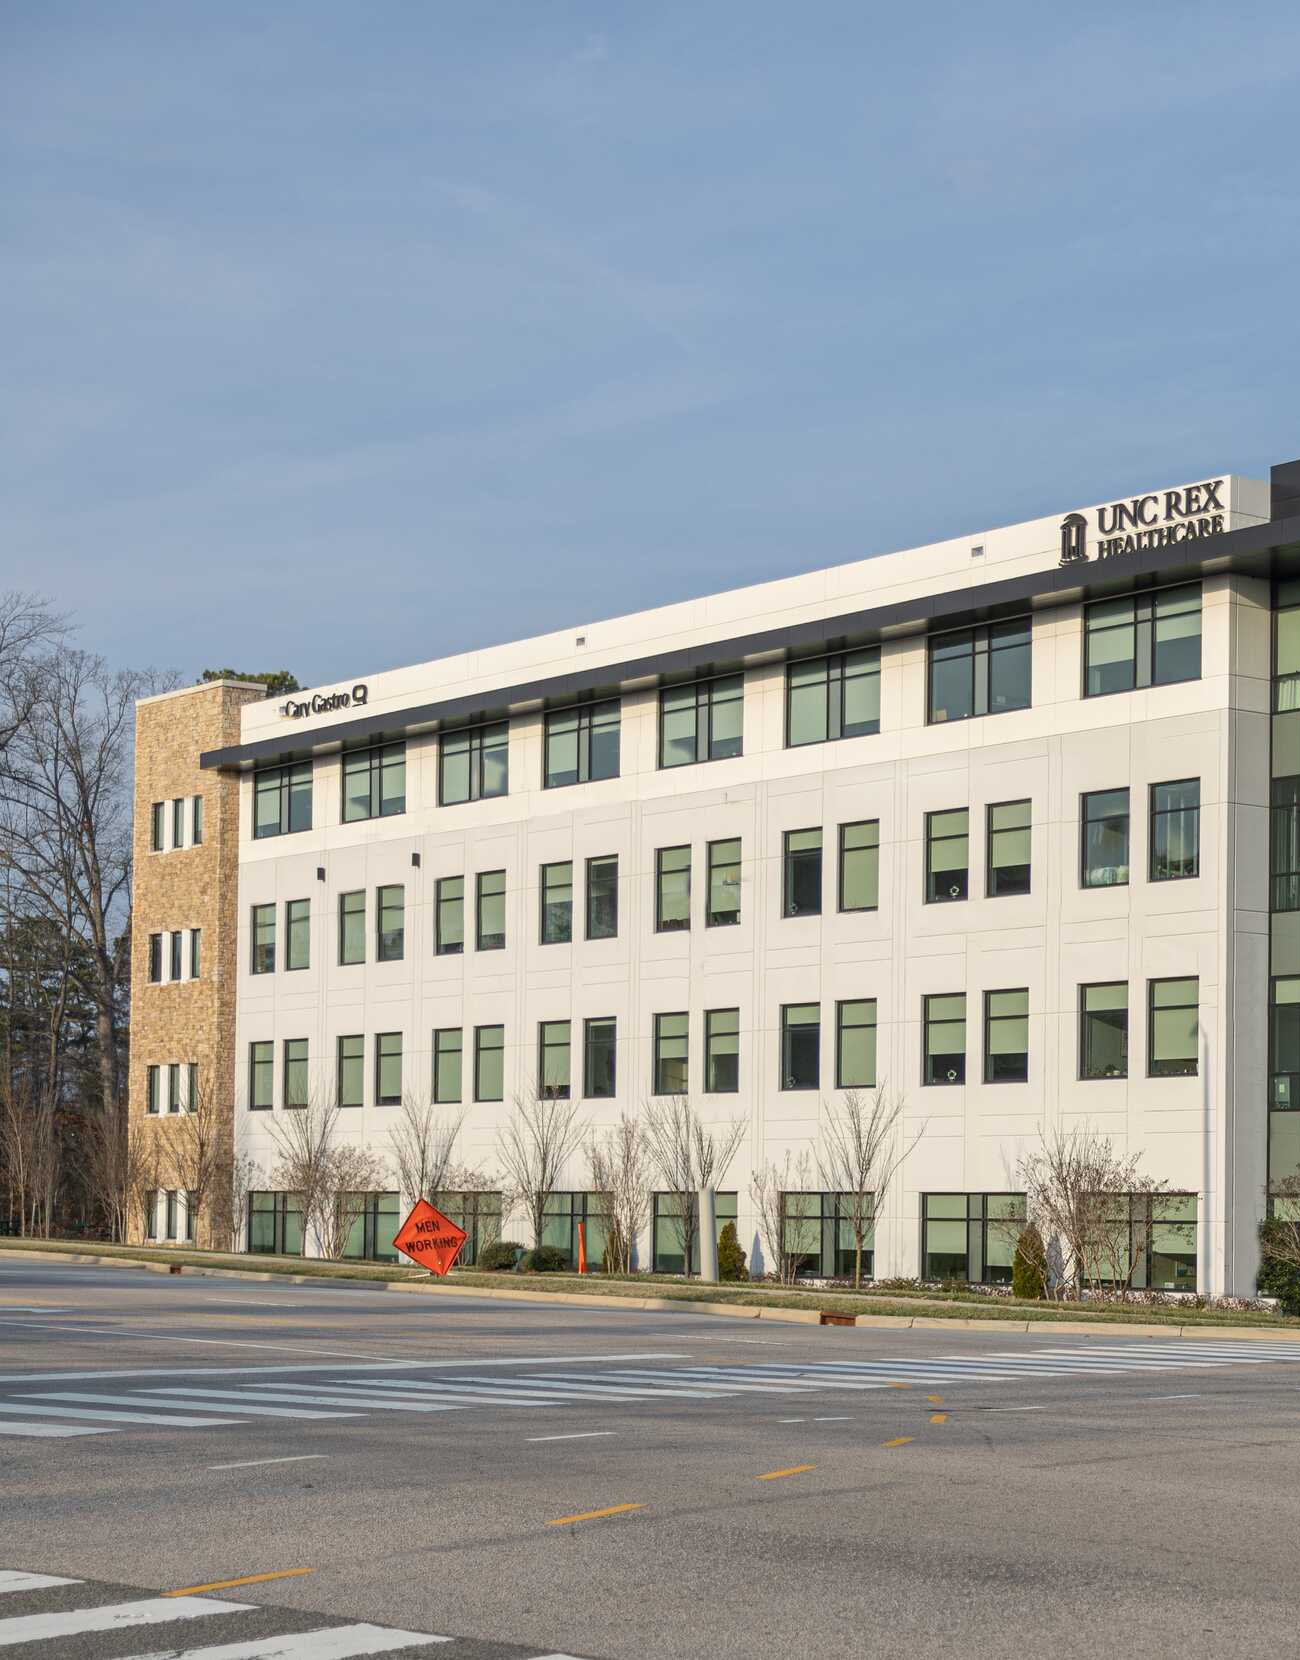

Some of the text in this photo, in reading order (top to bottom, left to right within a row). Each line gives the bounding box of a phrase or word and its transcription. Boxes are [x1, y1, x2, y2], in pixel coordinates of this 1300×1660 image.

[1096, 480, 1225, 536] UNC REX
[1097, 514, 1225, 561] HEALTHCARE
[285, 693, 351, 718] Cary Gastro
[415, 1220, 440, 1233] MEN
[405, 1236, 458, 1253] WORKING
